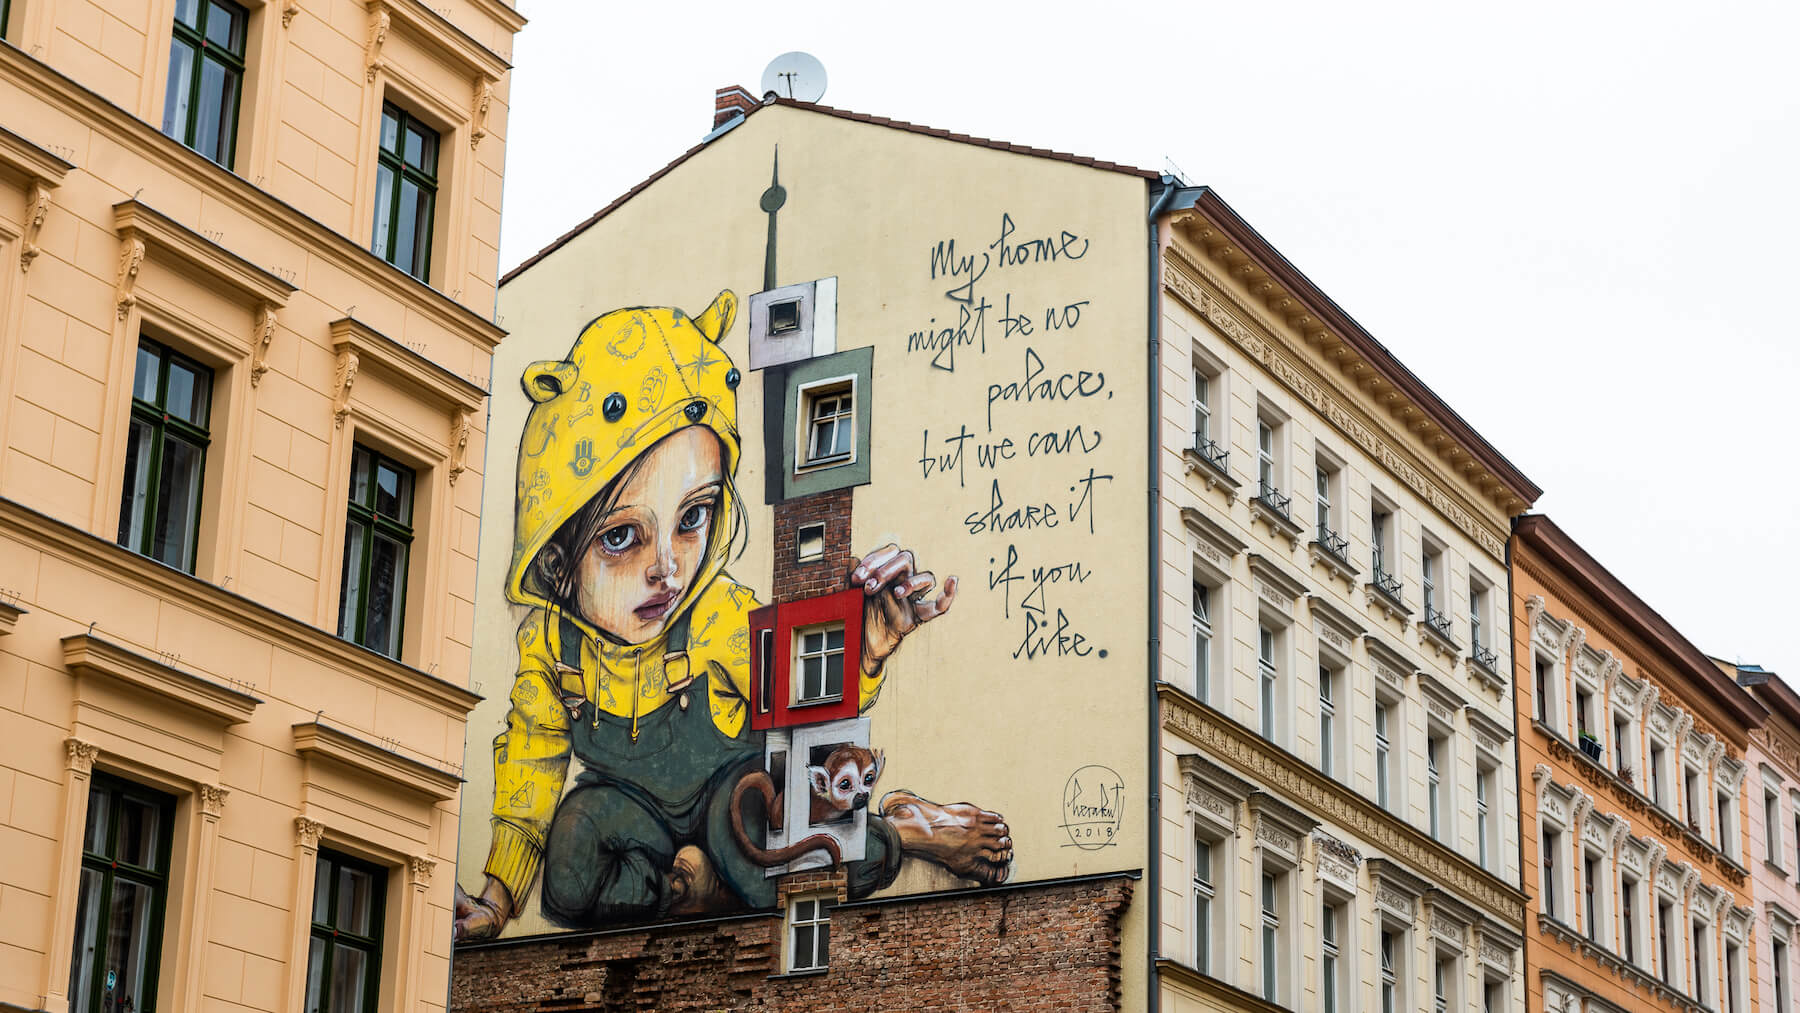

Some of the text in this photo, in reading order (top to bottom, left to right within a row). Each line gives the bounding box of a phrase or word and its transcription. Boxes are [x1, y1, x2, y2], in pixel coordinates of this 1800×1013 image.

[931, 212, 1089, 306] My home
[907, 293, 1090, 373] might be no
[918, 424, 1102, 488] but we can
[964, 468, 1114, 535] share it
[989, 544, 1092, 619] if you
[1012, 608, 1109, 660] like.
[1075, 826, 1113, 838] 2018
